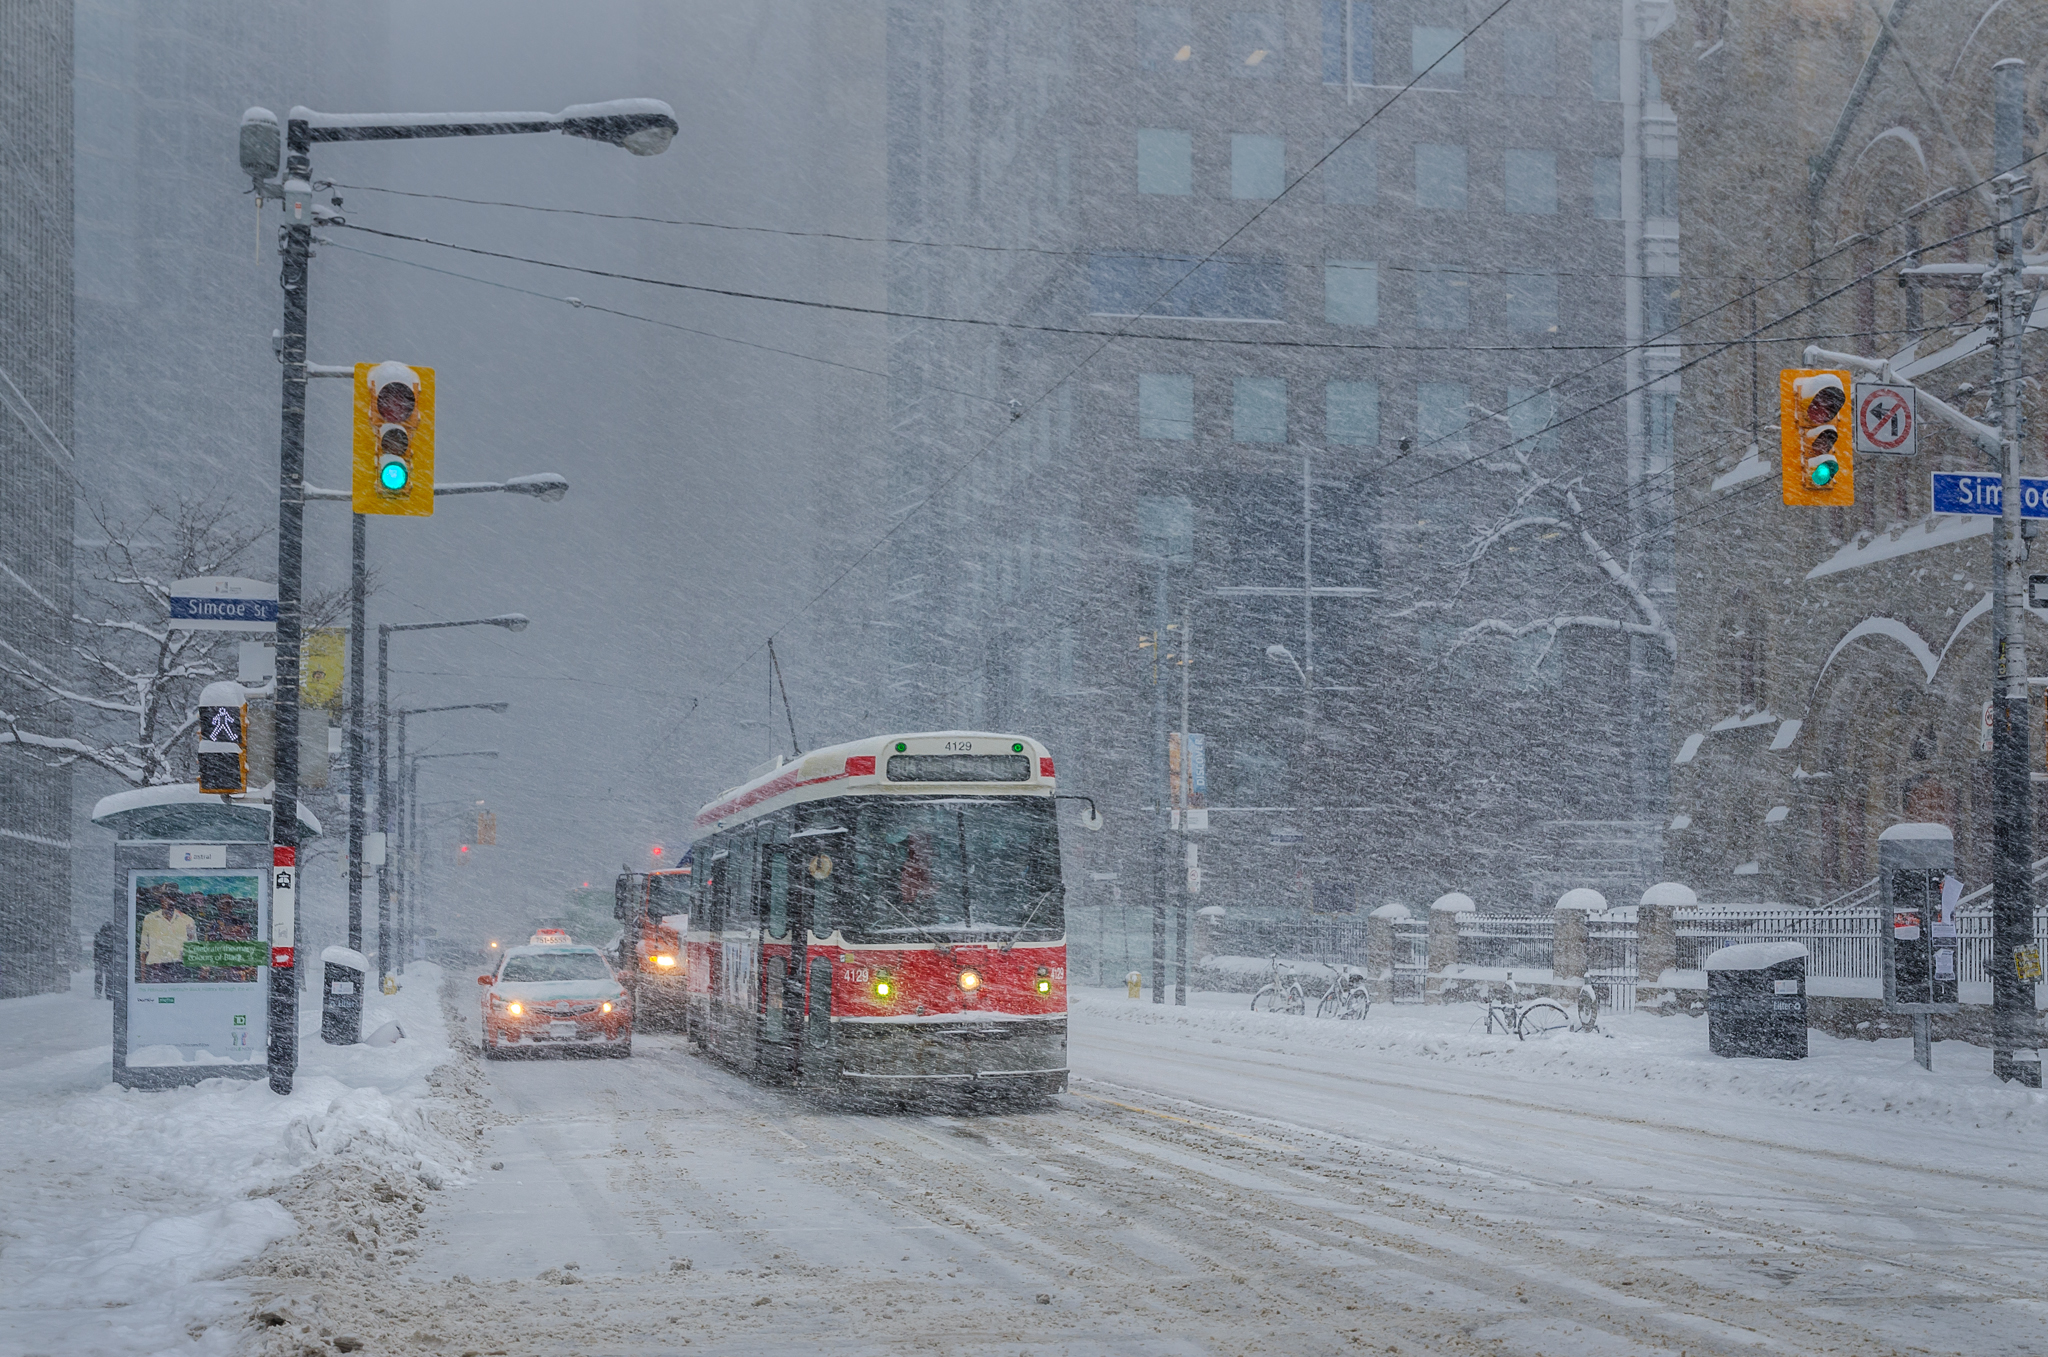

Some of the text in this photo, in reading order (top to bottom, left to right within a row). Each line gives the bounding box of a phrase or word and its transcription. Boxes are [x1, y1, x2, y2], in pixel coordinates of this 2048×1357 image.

[1959, 477, 2048, 508] Simo
[189, 599, 268, 617] Simcoe St
[944, 742, 972, 751] 4129
[1195, 738, 1205, 787] DISCOVER
[844, 970, 868, 982] 4129
[1051, 967, 1063, 980] 4129
